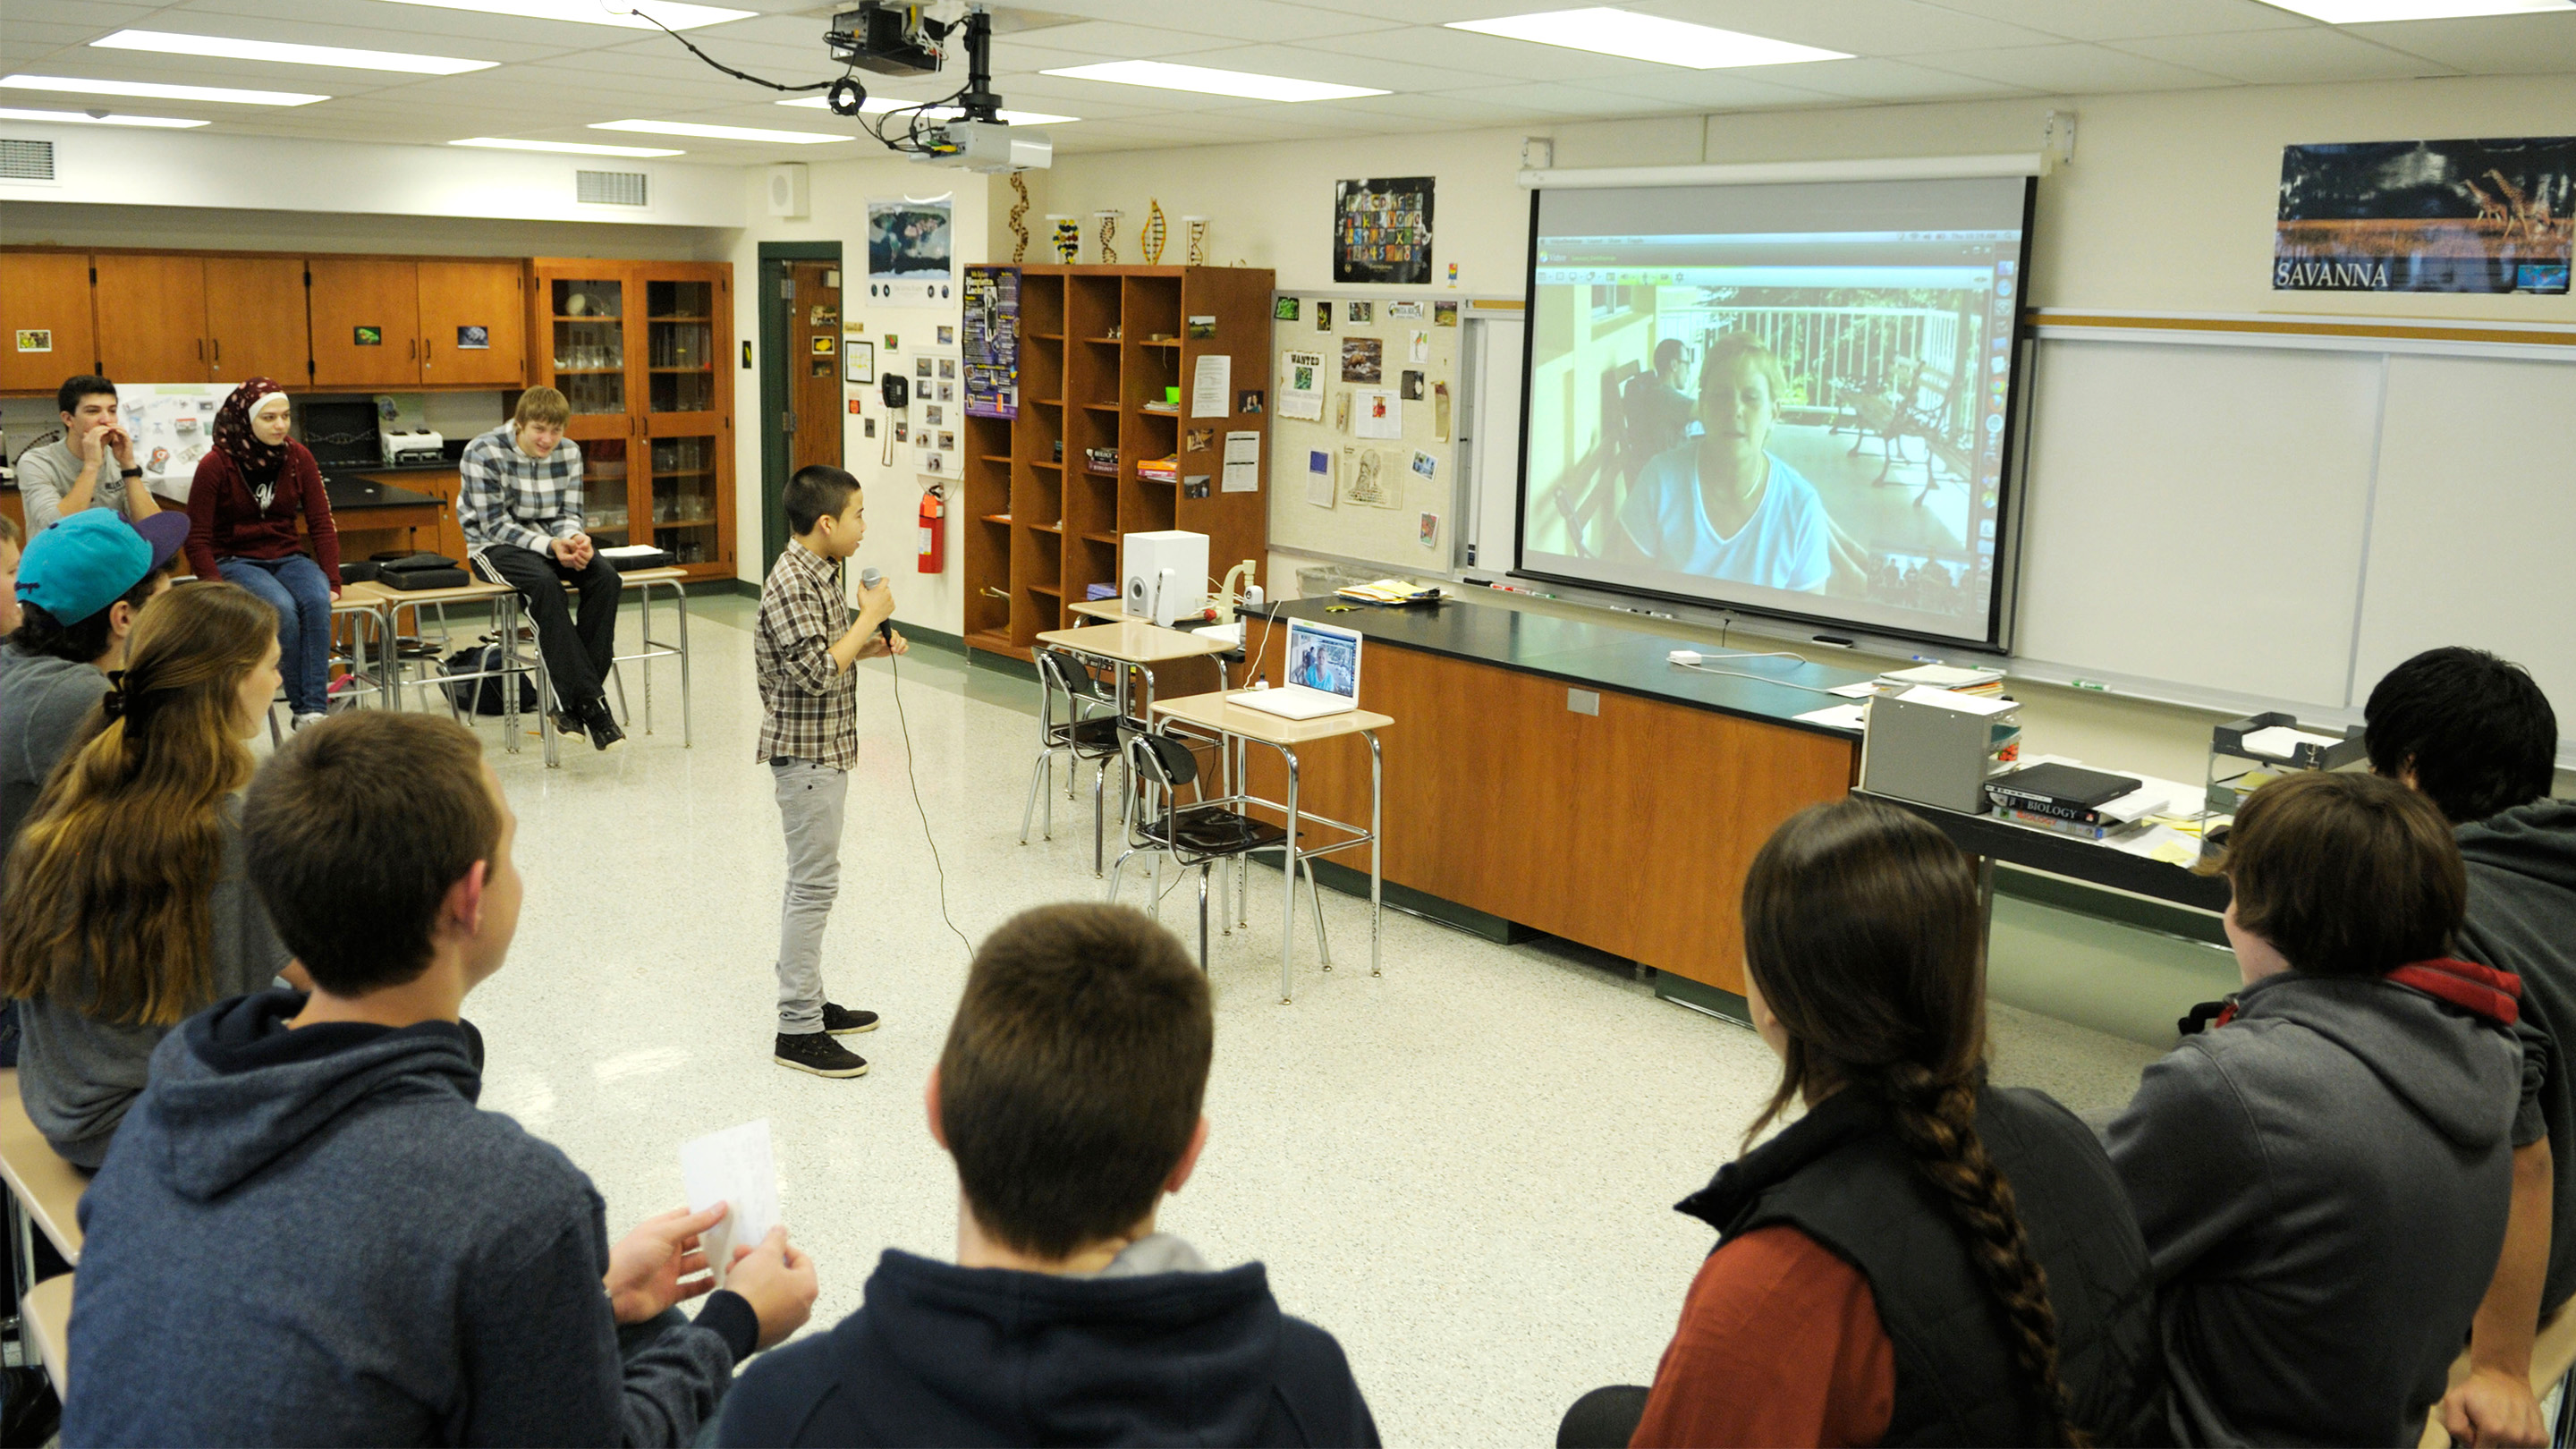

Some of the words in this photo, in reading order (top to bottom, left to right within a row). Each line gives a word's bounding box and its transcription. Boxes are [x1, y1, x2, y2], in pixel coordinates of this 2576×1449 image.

[2276, 262, 2389, 287] SAVANNA
[1291, 354, 1319, 366] WANTED
[2016, 810, 2056, 826] BIOLOGY
[2027, 801, 2077, 819] BIOLOGY
